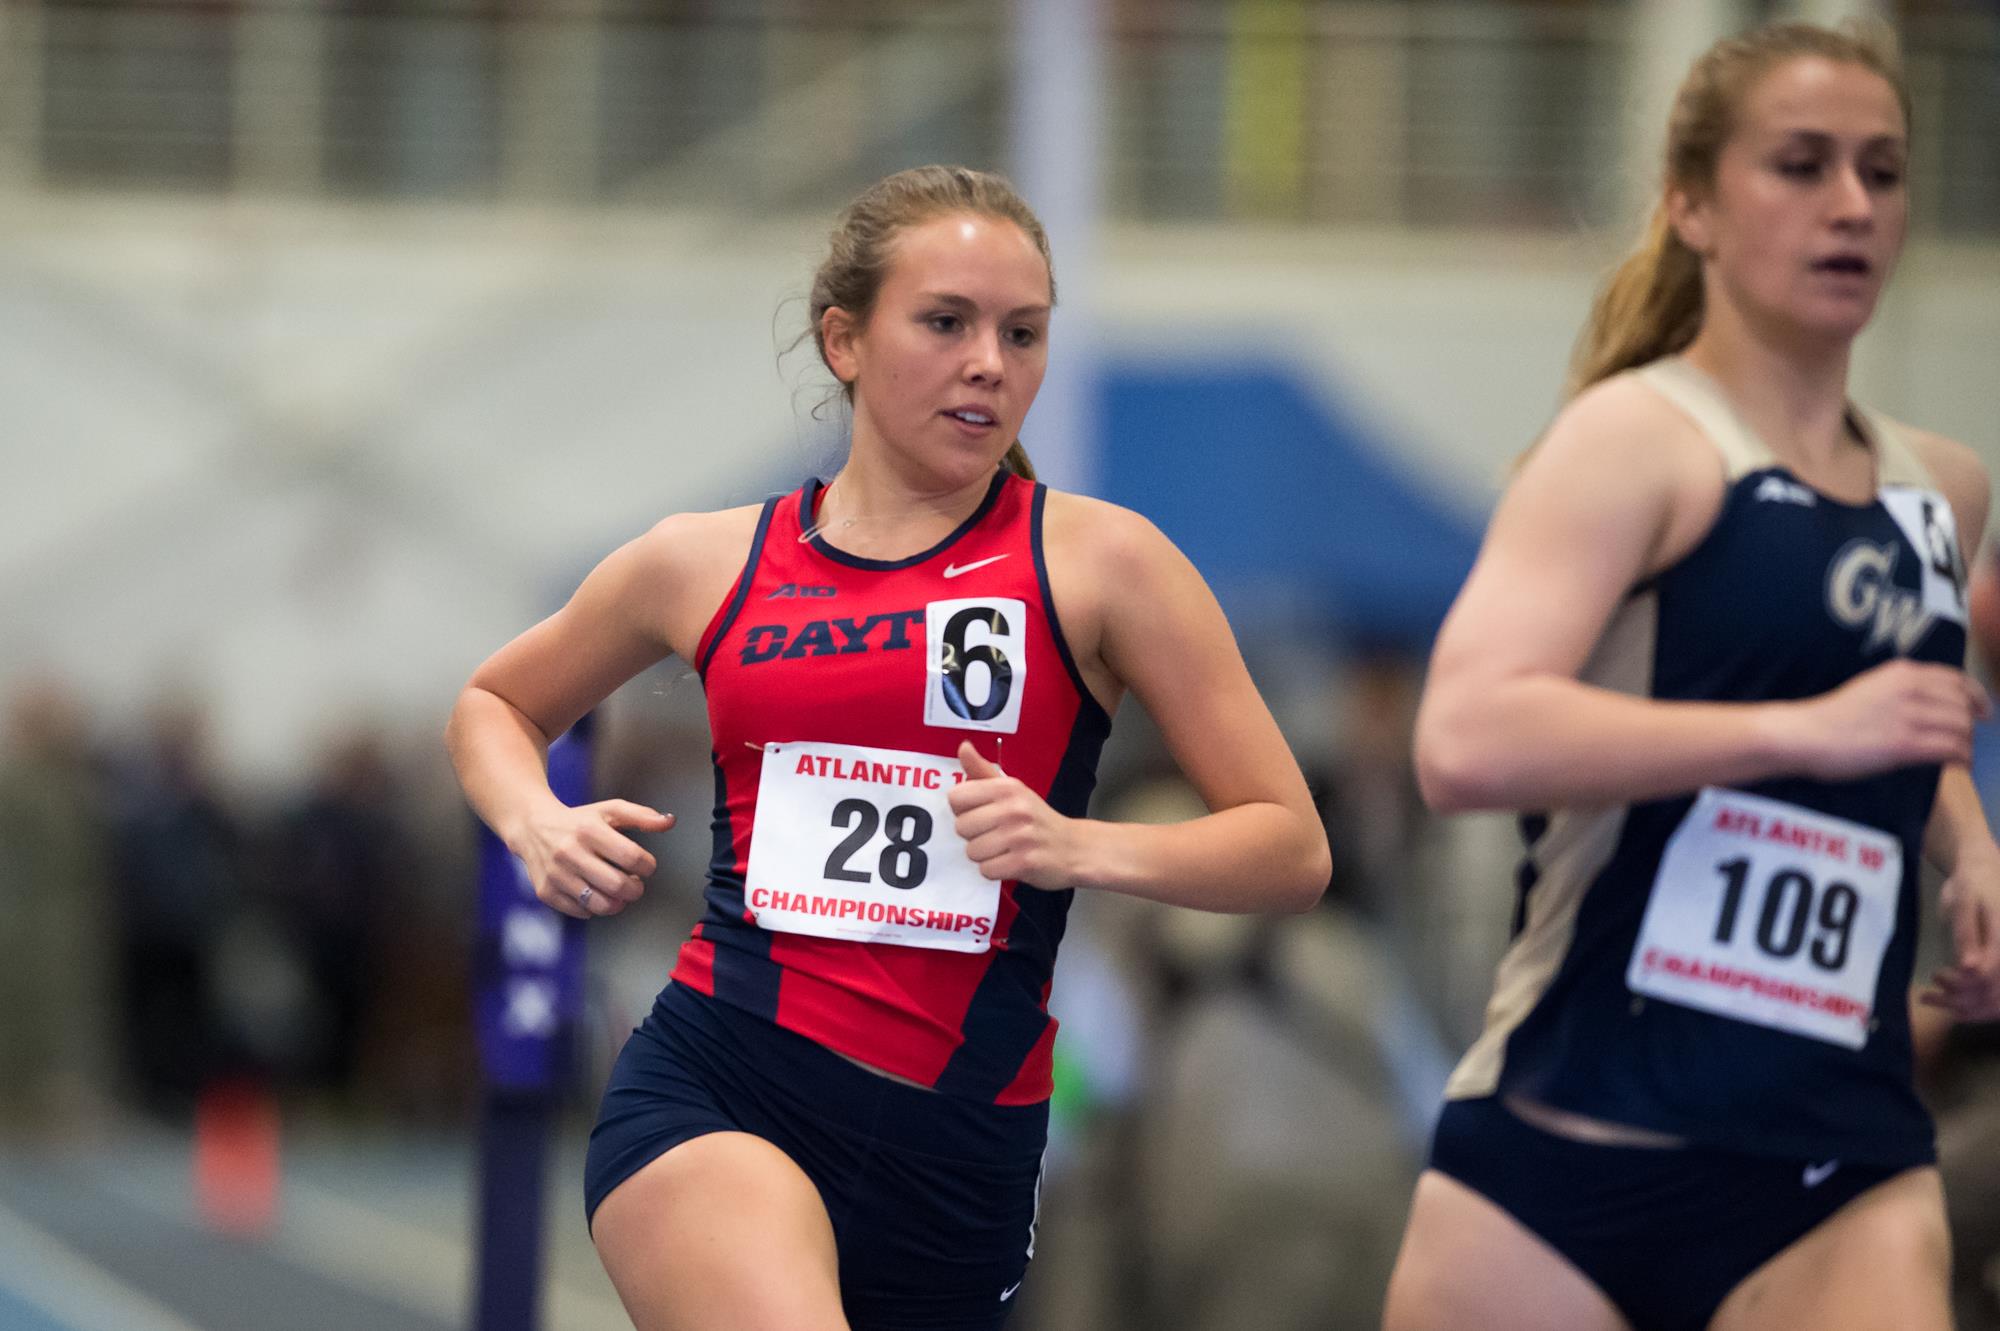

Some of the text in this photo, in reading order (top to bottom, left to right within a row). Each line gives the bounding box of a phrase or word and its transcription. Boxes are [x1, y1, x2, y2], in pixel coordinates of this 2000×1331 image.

[1824, 538, 1931, 654] GW
[942, 606, 1013, 721] 6
[796, 754, 942, 790] ATLANTIC
[823, 797, 933, 890] 28
[1713, 808, 1848, 862] ATLANTIC
[751, 887, 992, 936] CHAMPIONSHIPS
[1714, 854, 1860, 974] 109
